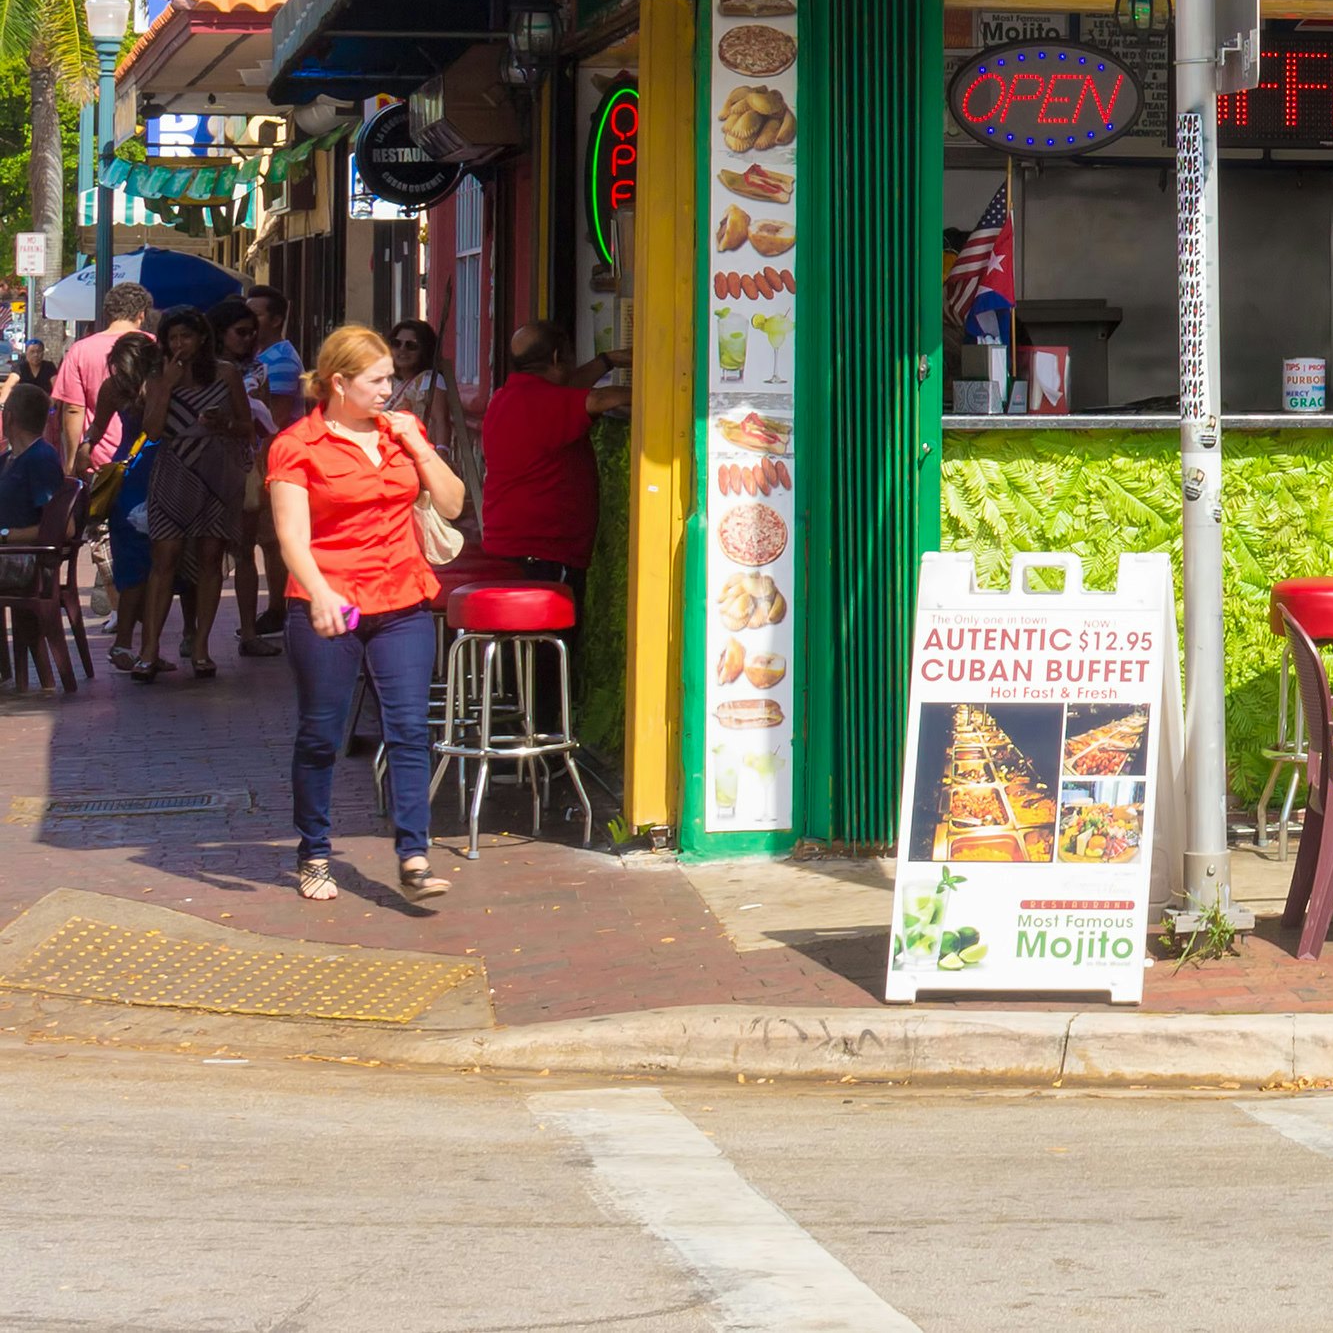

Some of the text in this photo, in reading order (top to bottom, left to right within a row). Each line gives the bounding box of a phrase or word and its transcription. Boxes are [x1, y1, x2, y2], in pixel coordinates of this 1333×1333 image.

[983, 22, 1060, 42] Mojito
[962, 72, 1124, 123] OPEN
[610, 103, 639, 209] OPE
[931, 614, 950, 624] The
[954, 614, 979, 627] Only
[983, 616, 1004, 625] one
[1007, 615, 1016, 624] in
[1020, 615, 1048, 625] town
[923, 628, 1153, 653] AUTENTIC $12.95
[921, 658, 1150, 683] CUBAN BUFFET
[990, 686, 1118, 699] Hot Fast & Fresh
[1030, 900, 1130, 909] RESTAURANT
[1017, 914, 1134, 929] Most Famous
[1016, 930, 1134, 966] Mojito
